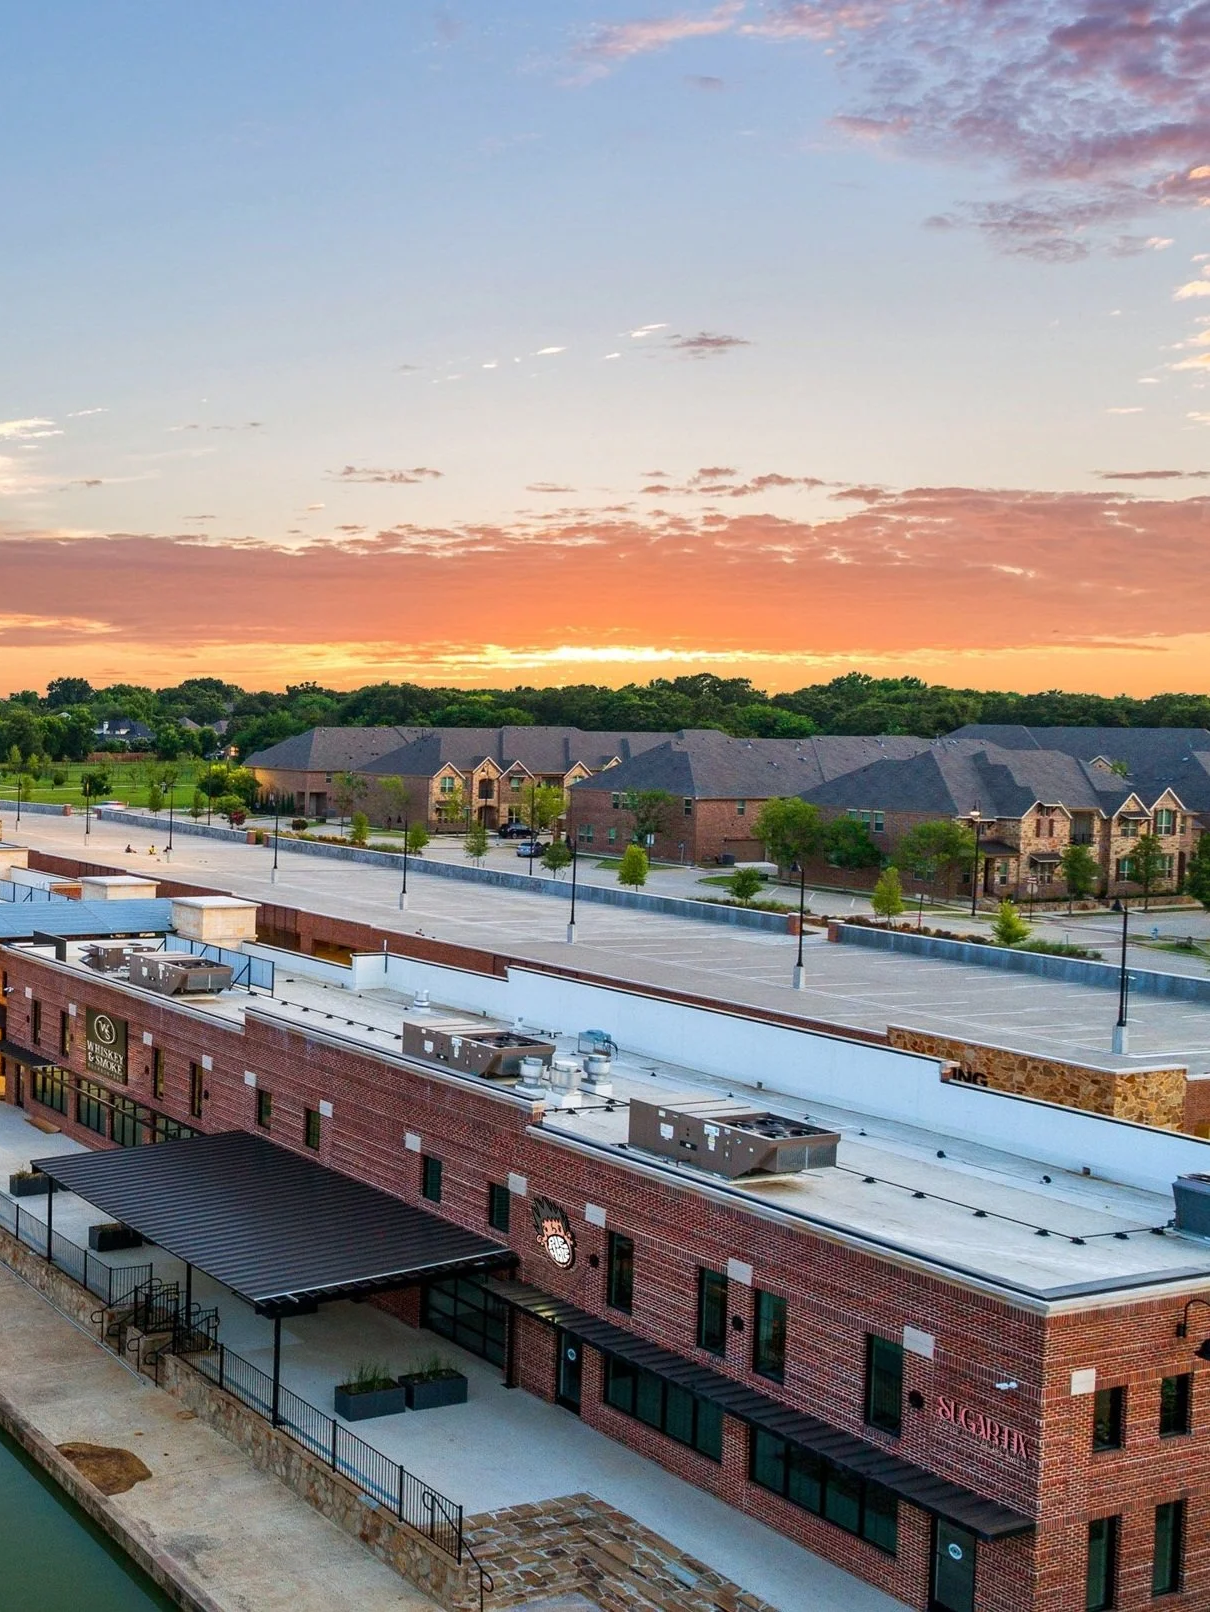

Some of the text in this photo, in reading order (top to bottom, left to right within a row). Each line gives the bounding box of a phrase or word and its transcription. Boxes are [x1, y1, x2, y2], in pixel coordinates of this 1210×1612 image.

[86, 1039, 124, 1066] WHISKEY
[88, 1051, 94, 1062] &
[95, 1055, 123, 1076] SMOKE
